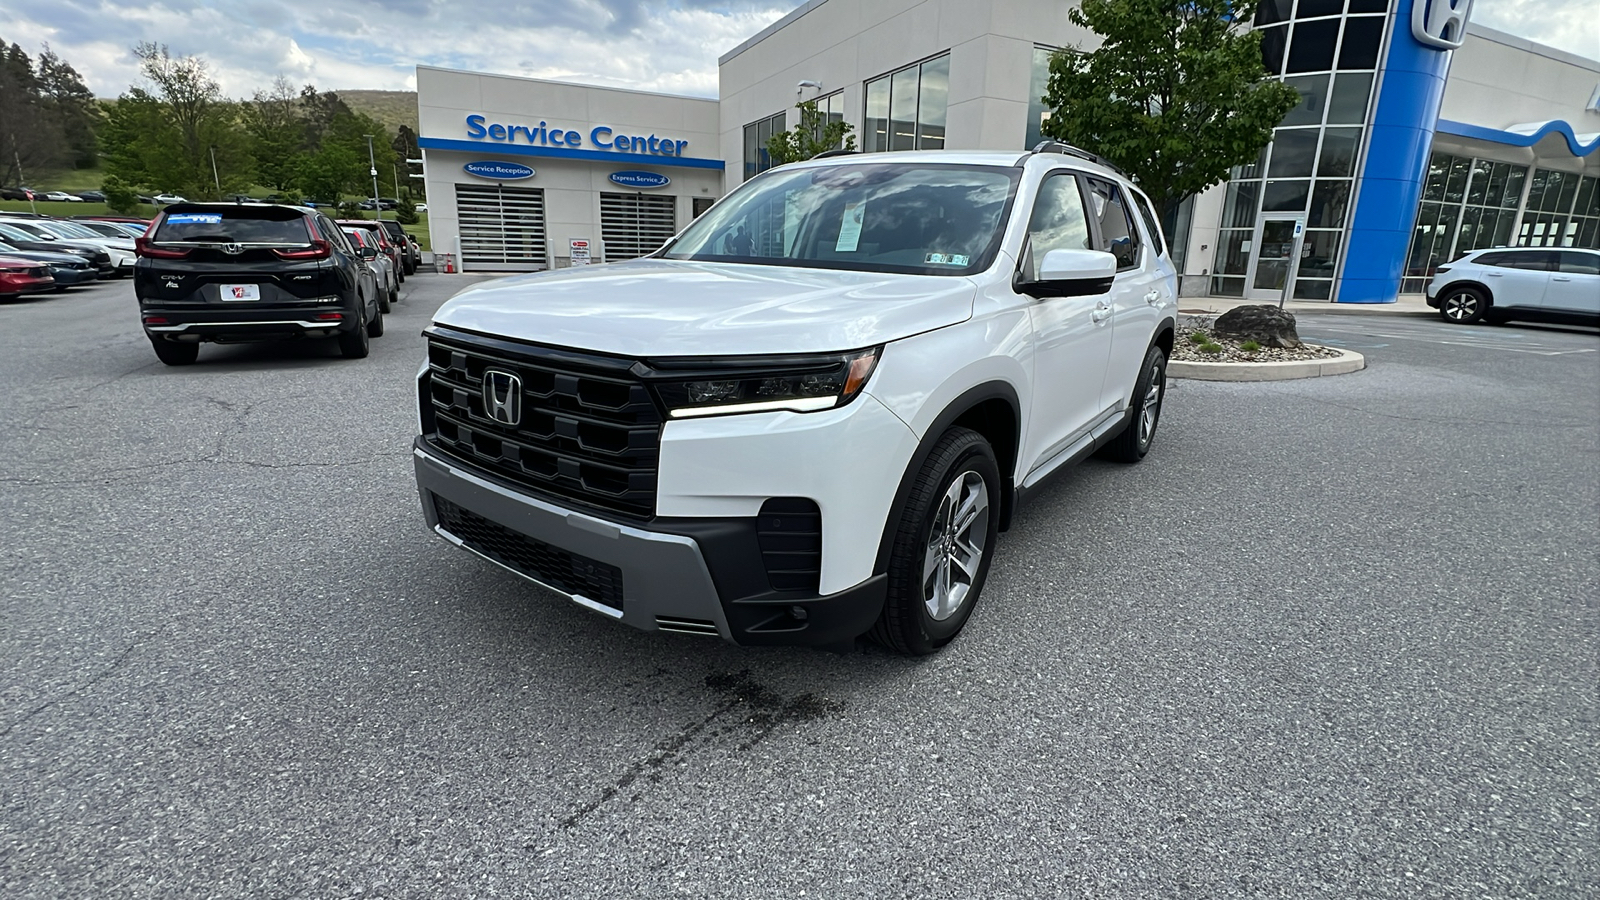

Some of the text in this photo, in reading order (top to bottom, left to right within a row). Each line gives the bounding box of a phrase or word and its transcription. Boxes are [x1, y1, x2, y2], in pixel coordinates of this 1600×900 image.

[466, 114, 689, 157] Service Center
[468, 165, 531, 175] Service Reception
[612, 174, 658, 183] Express Service
